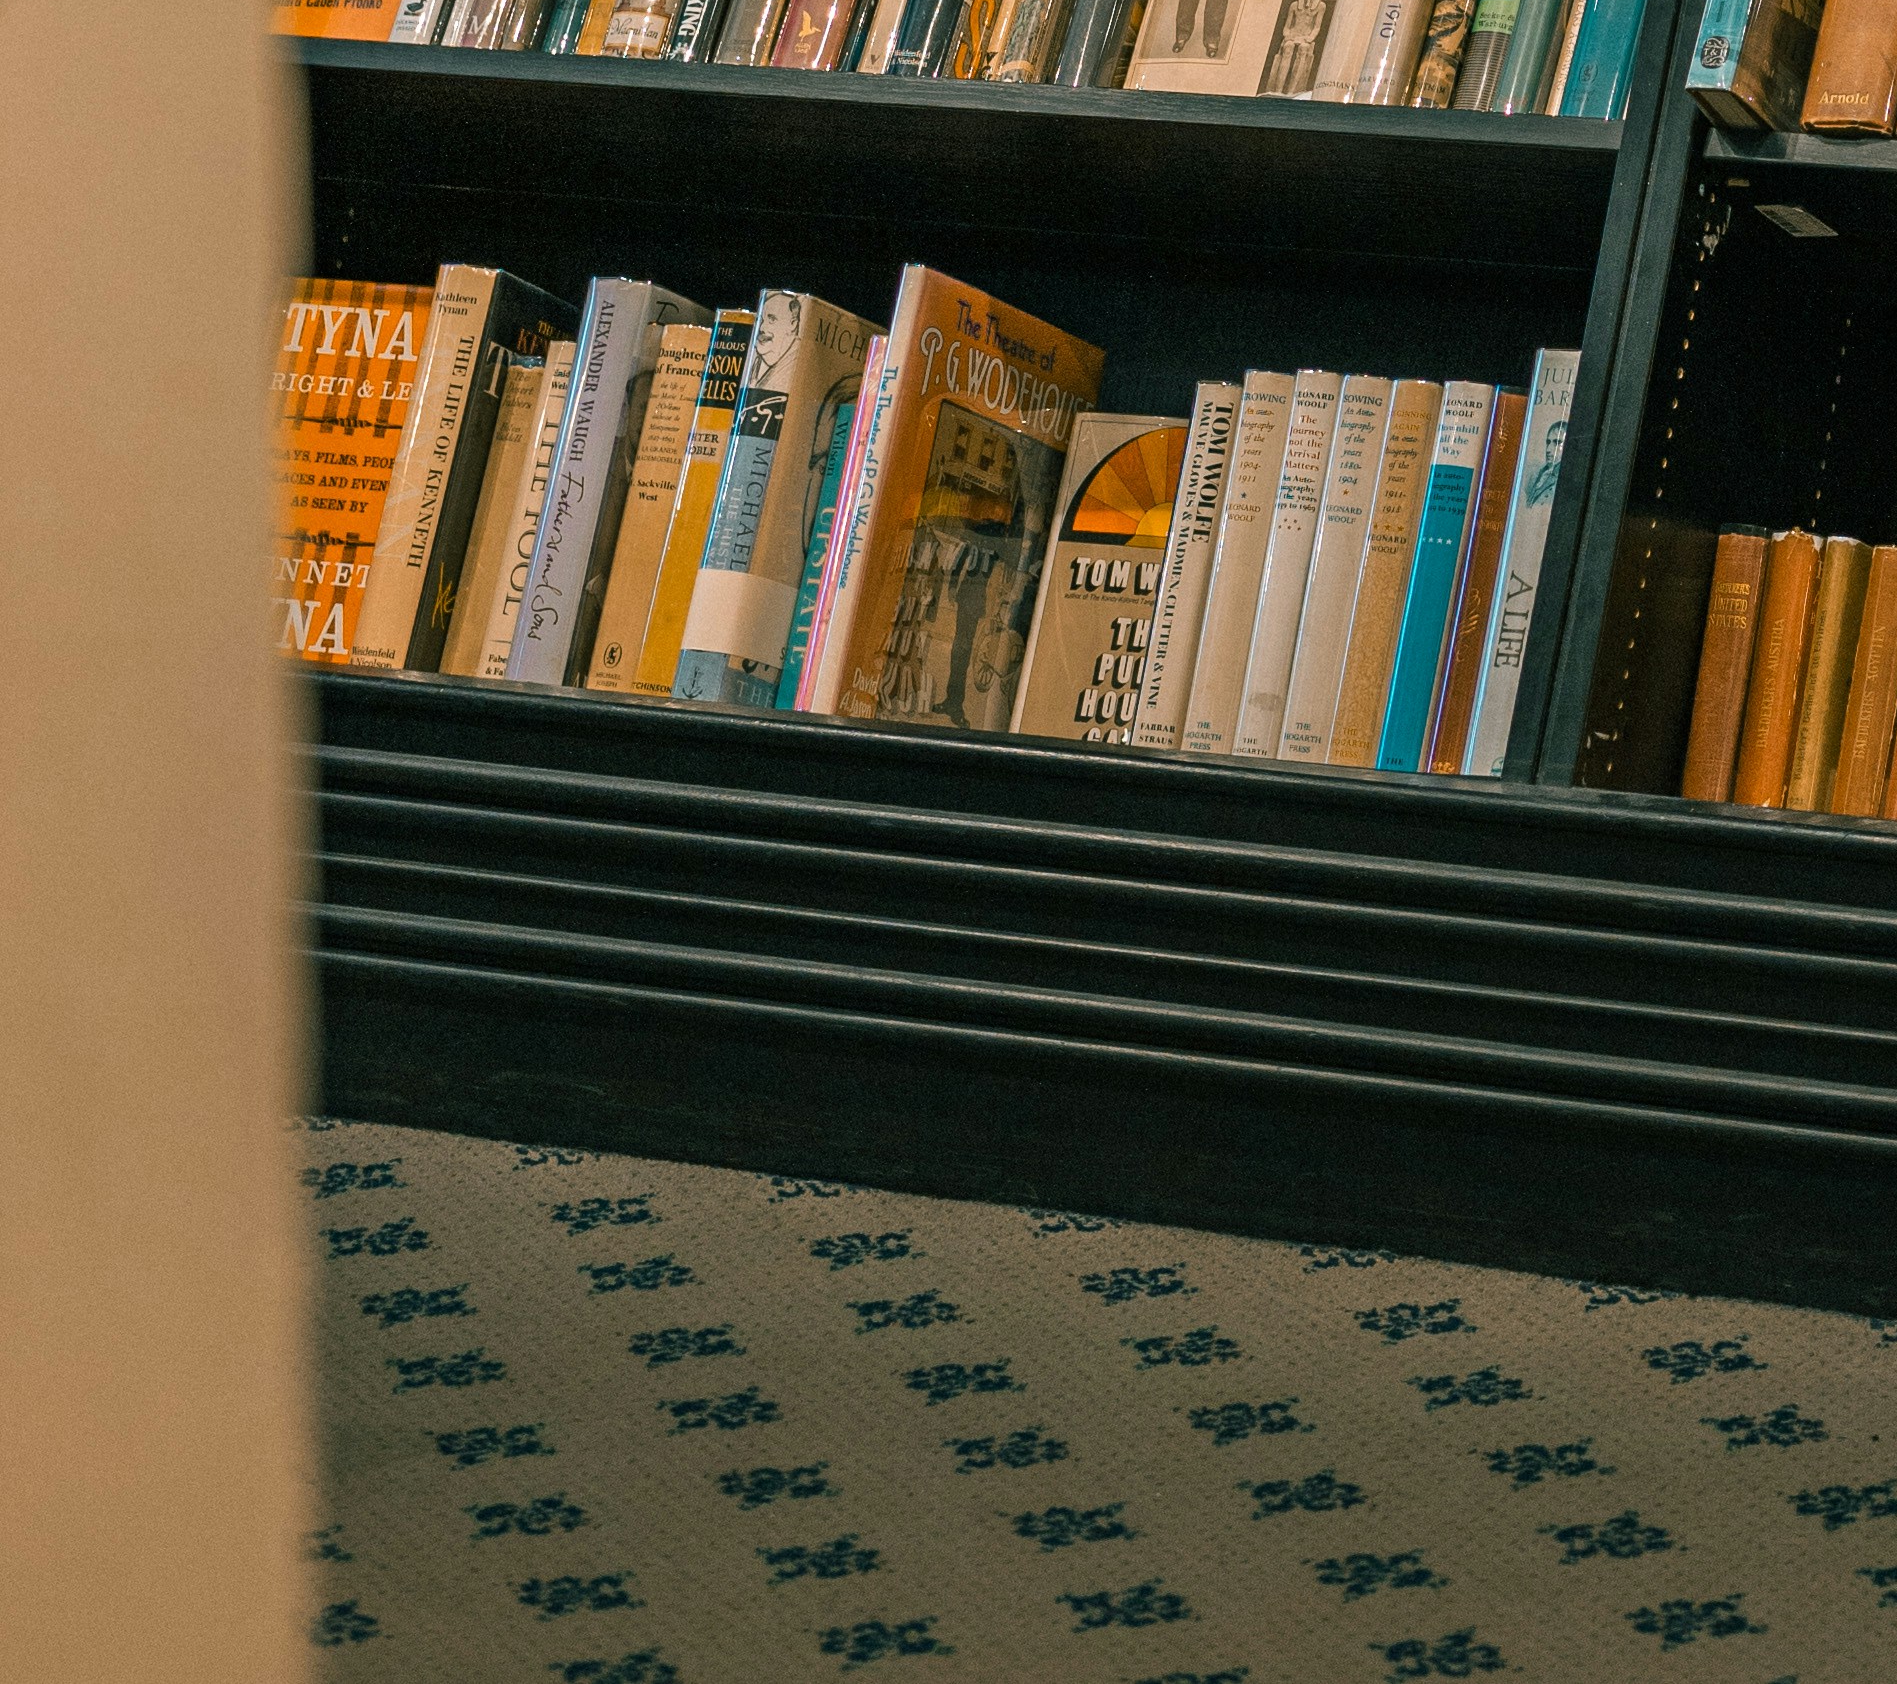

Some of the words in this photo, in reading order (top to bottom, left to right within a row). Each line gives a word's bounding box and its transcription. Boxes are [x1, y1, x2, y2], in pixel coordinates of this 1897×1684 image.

[454, 335, 475, 378] THE
[584, 300, 616, 394] ALEXANDER
[441, 383, 464, 431] LIFE
[568, 398, 595, 464] WAUGH
[1208, 402, 1235, 455] TOM
[432, 439, 452, 464] OF
[407, 469, 443, 569] KENNETH
[1192, 460, 1223, 543] WOLFE
